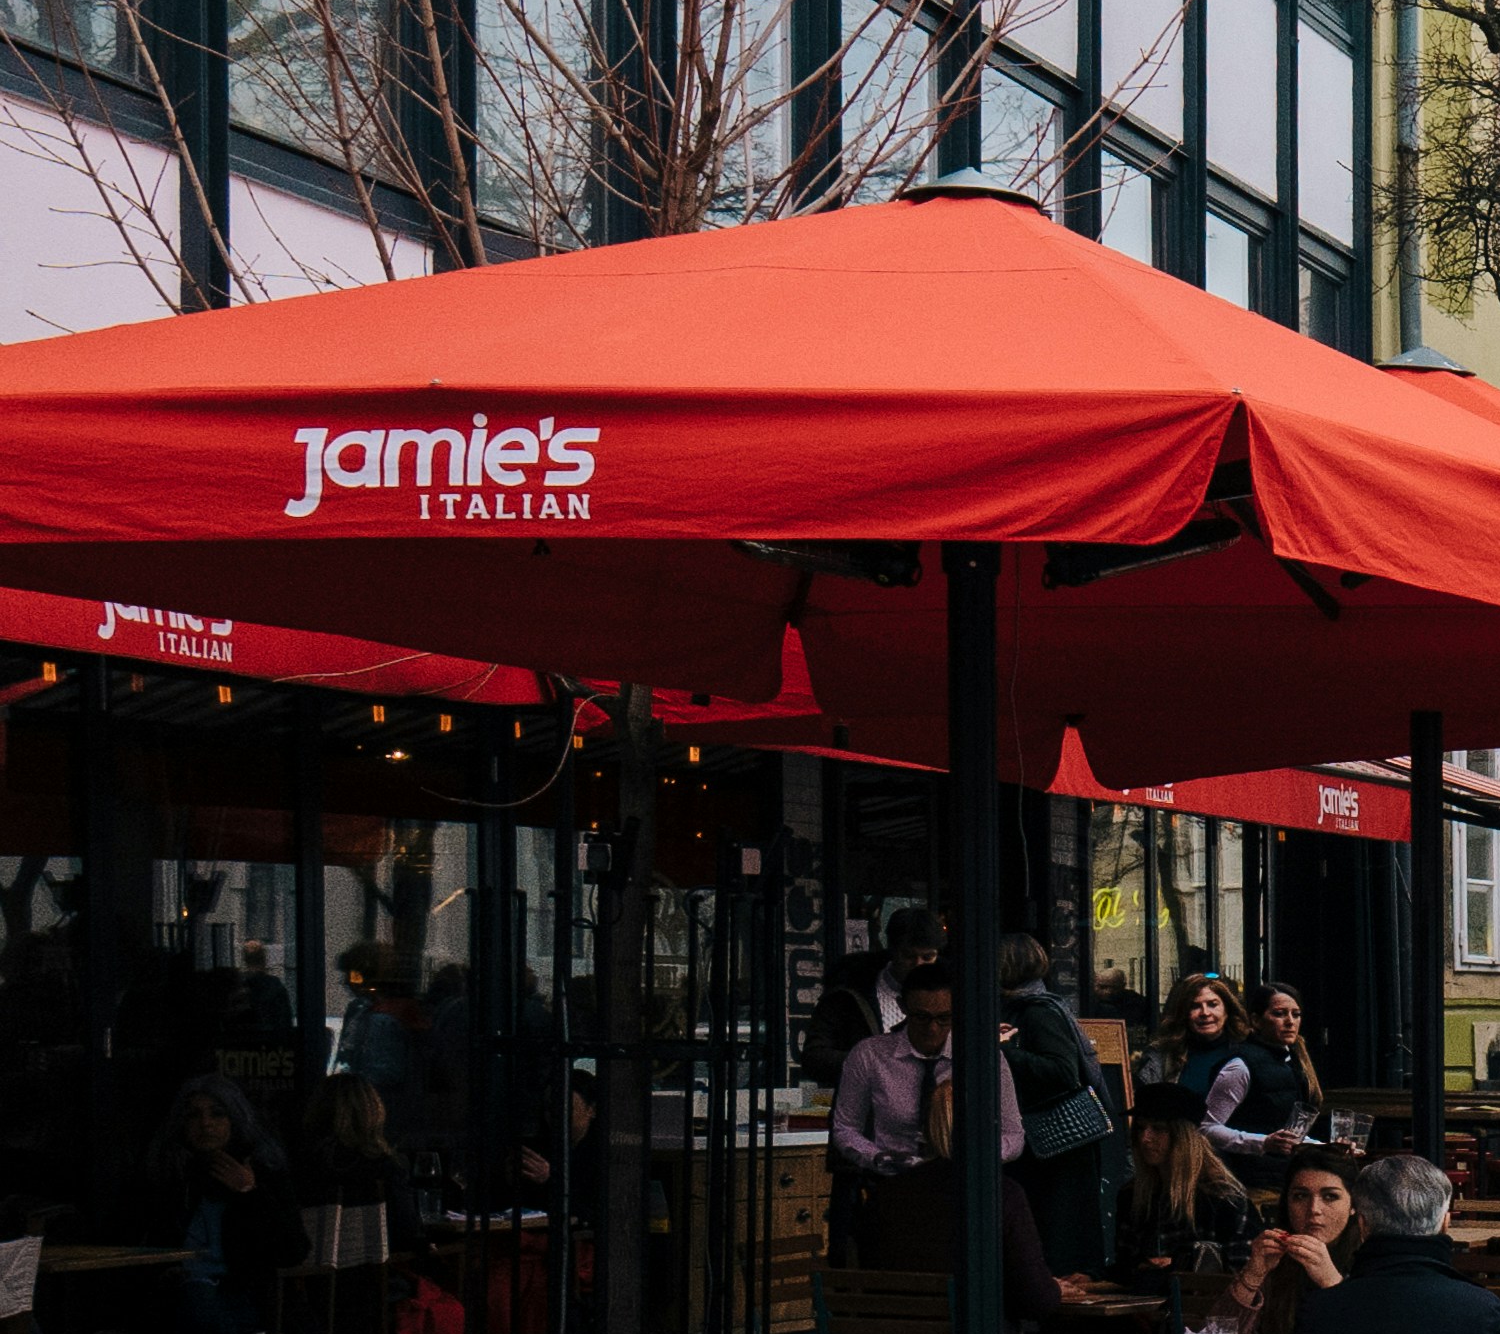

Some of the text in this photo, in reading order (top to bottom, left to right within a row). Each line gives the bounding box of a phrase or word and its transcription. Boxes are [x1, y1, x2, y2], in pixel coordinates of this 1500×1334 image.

[284, 413, 600, 517] Jamie's
[419, 494, 591, 519] ITALIAN
[158, 631, 234, 663] ITALIAN
[1145, 787, 1174, 804] ITALIAN
[1318, 783, 1360, 825] Jamie's
